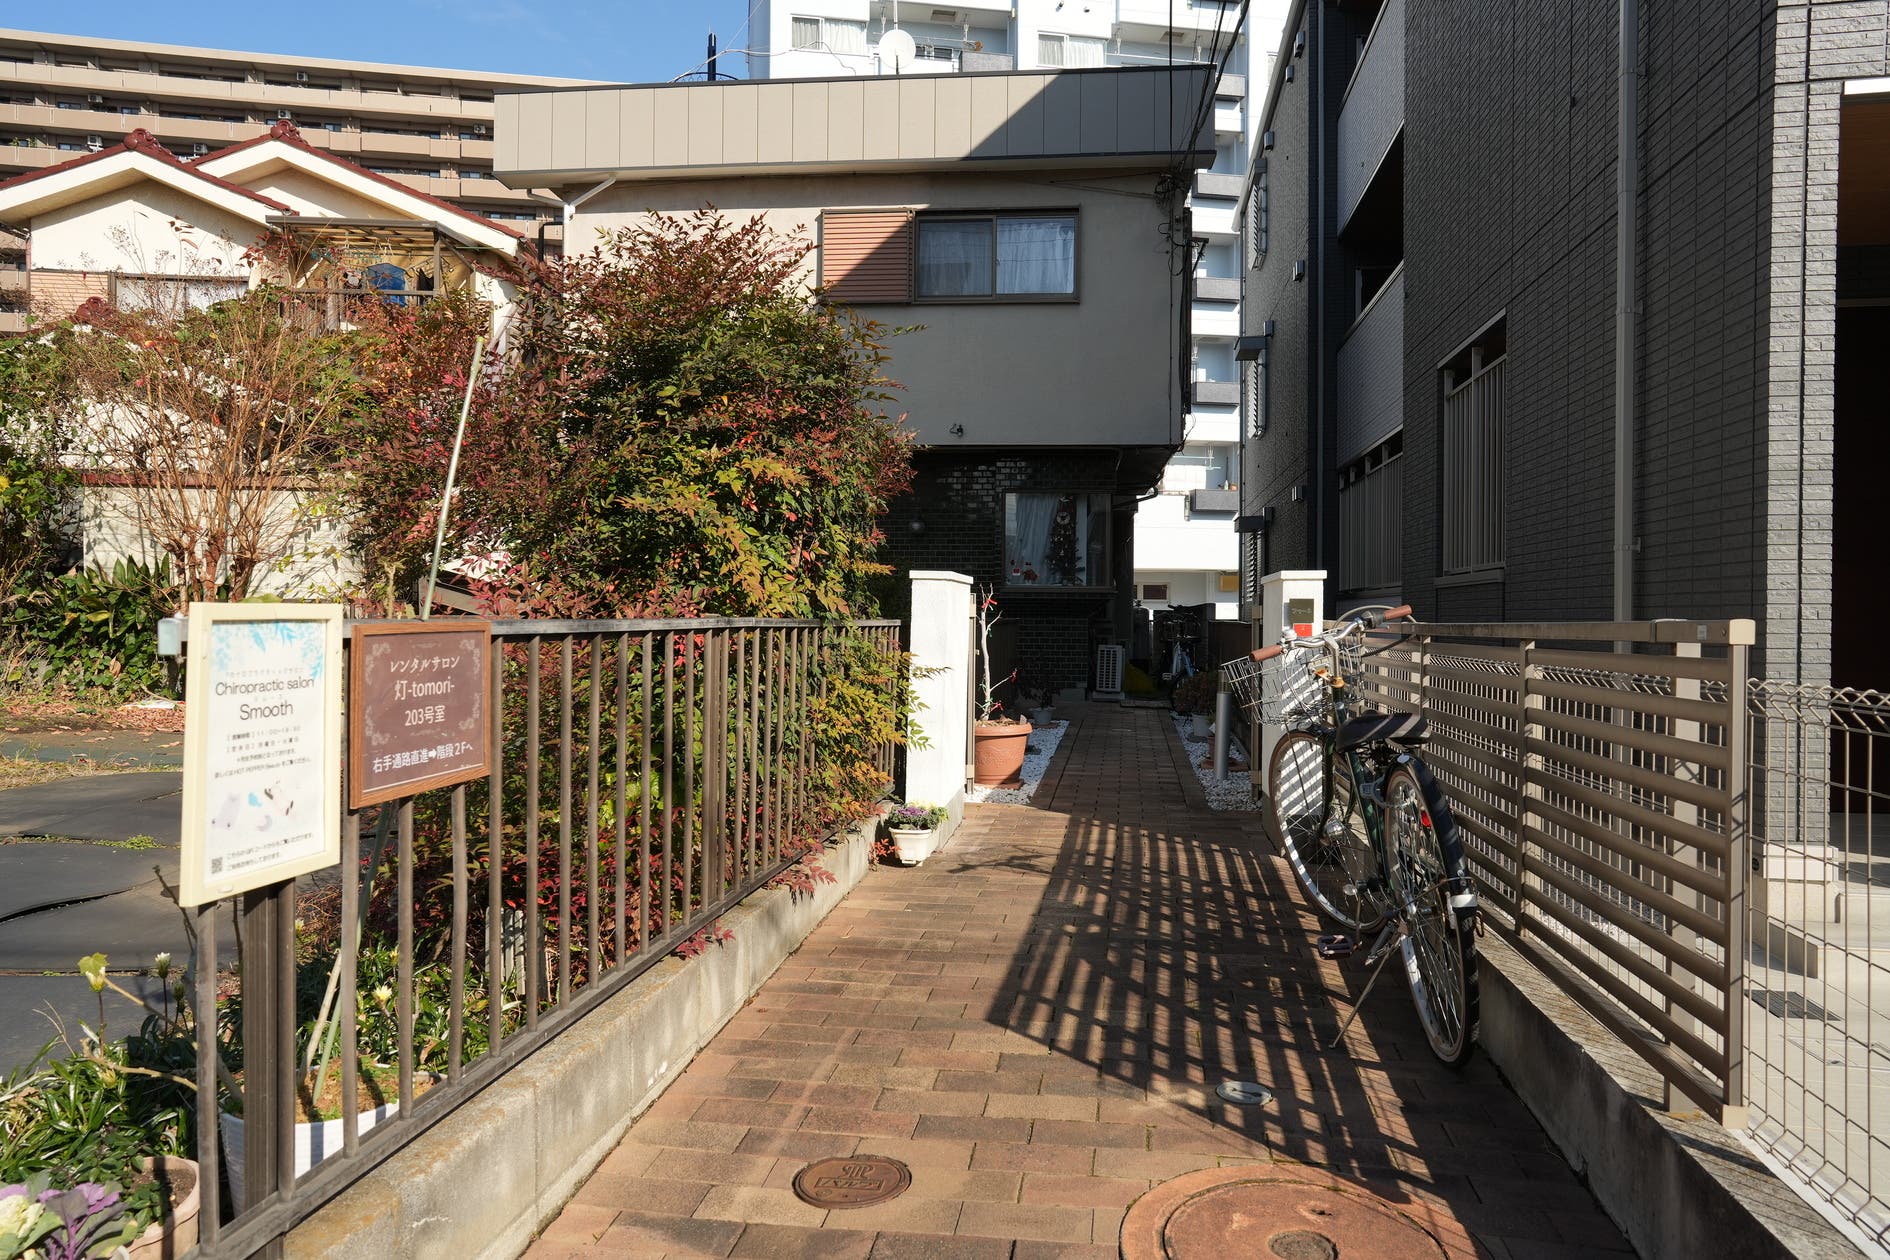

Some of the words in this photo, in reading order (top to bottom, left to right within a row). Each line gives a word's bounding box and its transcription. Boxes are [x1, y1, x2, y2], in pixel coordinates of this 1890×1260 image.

[390, 656, 460, 673] レンタルサロン
[215, 678, 284, 696] Chiropractic
[394, 676, 455, 701] 灯-tomori-
[239, 700, 294, 722] Smooth
[404, 705, 446, 727] 203号室
